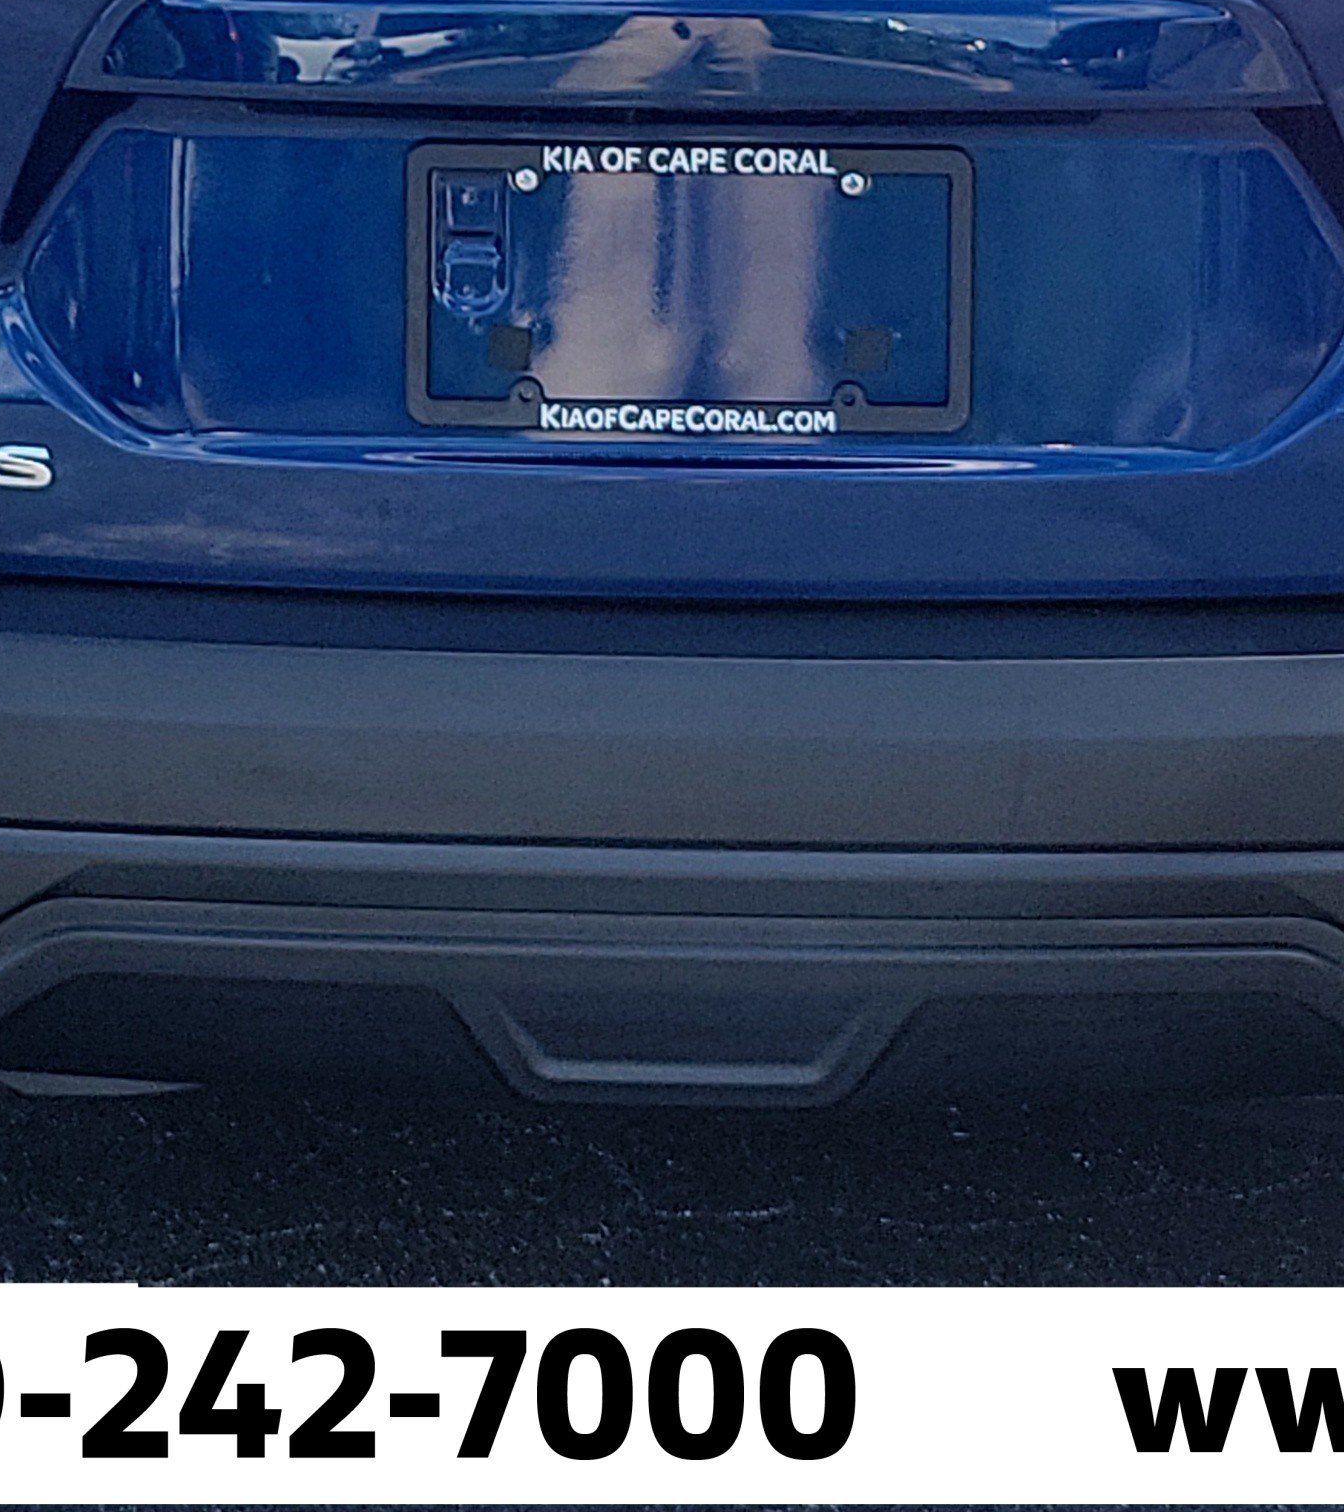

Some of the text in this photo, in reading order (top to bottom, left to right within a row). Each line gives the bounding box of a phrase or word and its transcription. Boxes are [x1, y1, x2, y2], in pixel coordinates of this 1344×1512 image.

[542, 145, 836, 175] KIA OF CAPE CORAL
